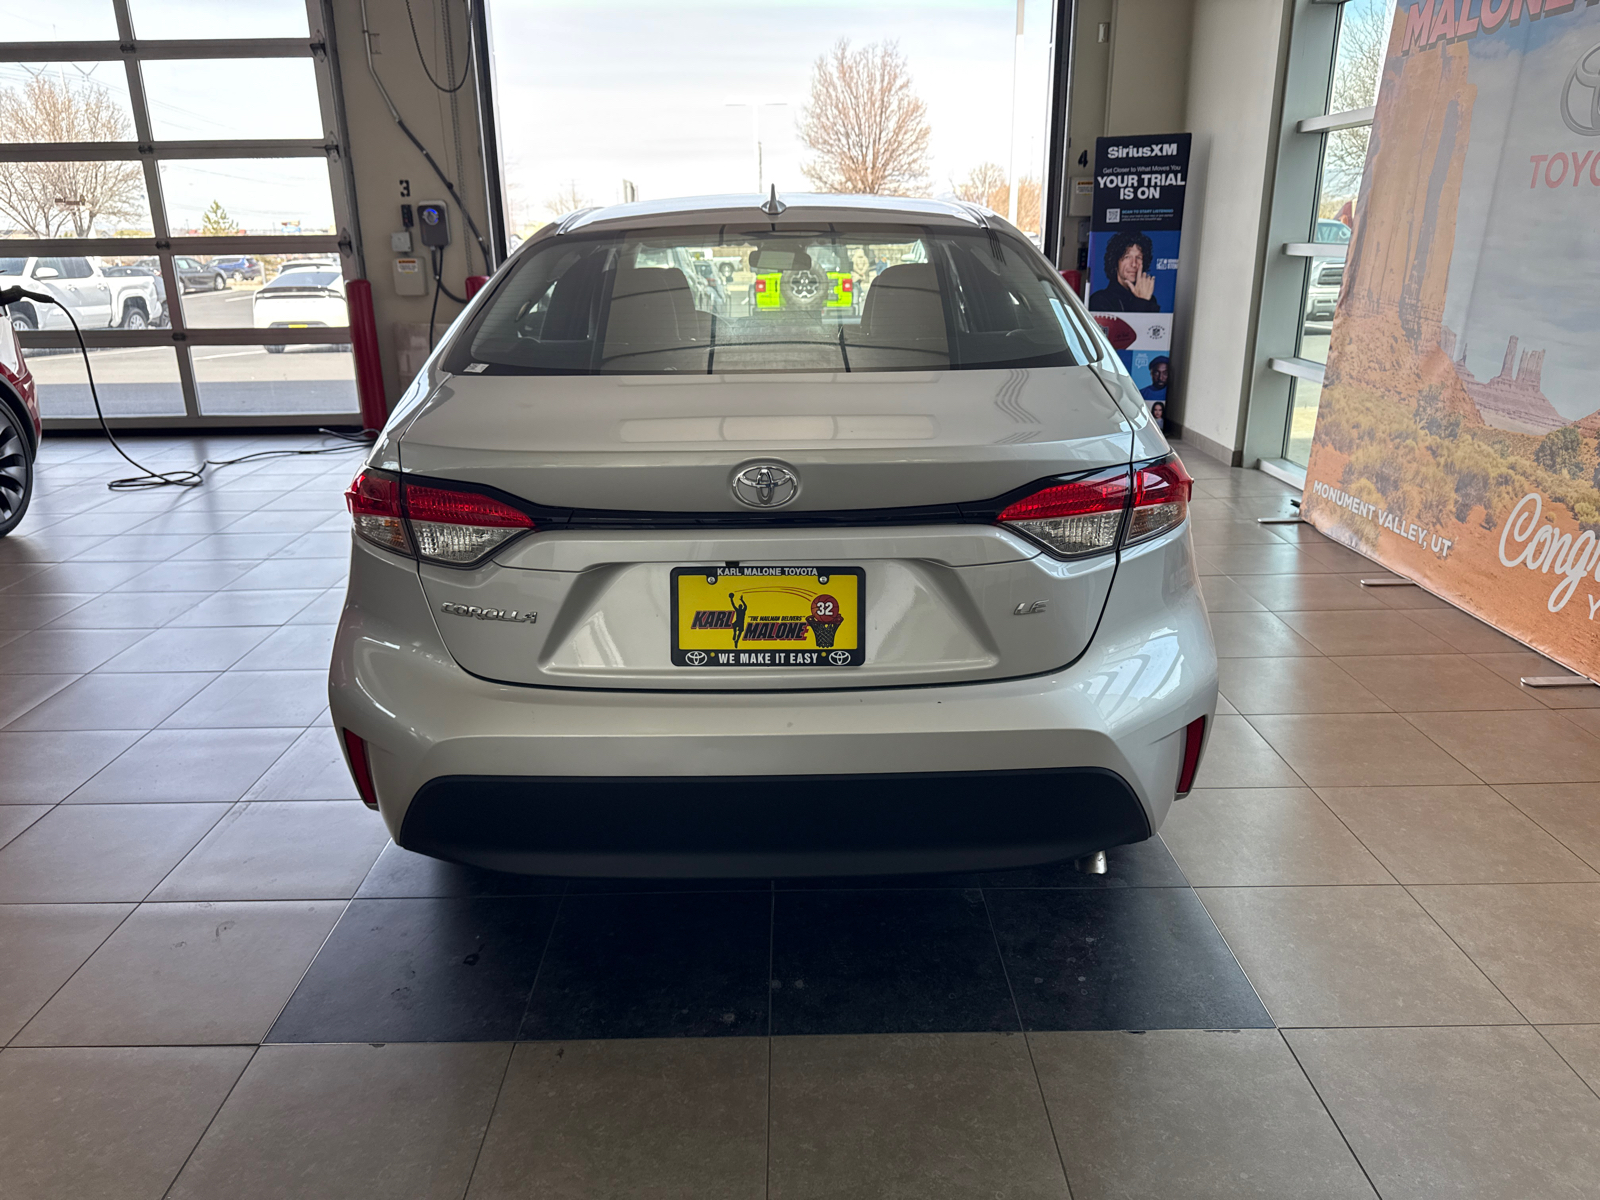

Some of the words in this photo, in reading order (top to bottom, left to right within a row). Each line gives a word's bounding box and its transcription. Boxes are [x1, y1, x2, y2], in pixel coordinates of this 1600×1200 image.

[1401, 0, 1575, 58] MALO
[1078, 149, 1088, 167] 4
[1107, 143, 1178, 159] SiriusXM
[399, 180, 410, 197] 3
[1097, 175, 1138, 188] YOUR
[1141, 173, 1186, 187] TRIAL
[1120, 187, 1134, 200] IS
[1136, 186, 1160, 199] ON
[1312, 480, 1376, 521] MONUMENT
[1378, 509, 1428, 550] VALLEY,
[1430, 534, 1452, 557] UT
[716, 567, 742, 576] KARL
[743, 567, 782, 576] MALONE
[783, 567, 818, 576] TOYOTA
[441, 601, 538, 624] COROLLA
[816, 601, 834, 616] 32
[1013, 599, 1050, 616] LE
[691, 610, 735, 630] KARL
[742, 621, 809, 641] MALONE
[718, 652, 735, 664] WE
[739, 652, 771, 664] MAKE
[775, 652, 786, 664] IT
[789, 652, 818, 664] EASY
